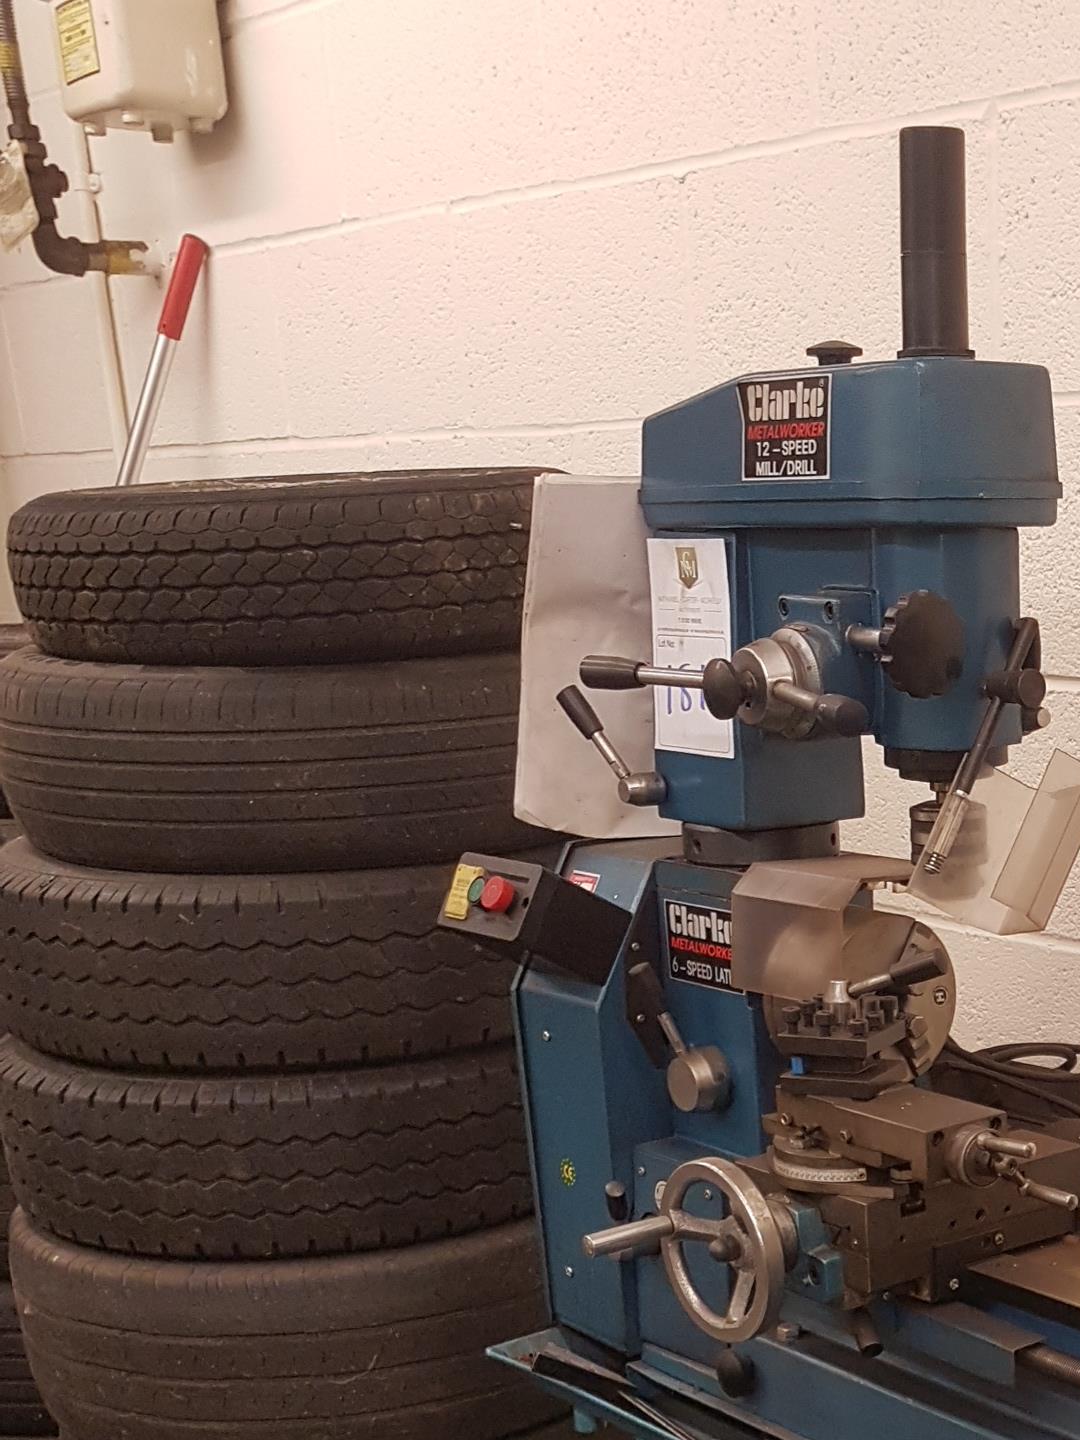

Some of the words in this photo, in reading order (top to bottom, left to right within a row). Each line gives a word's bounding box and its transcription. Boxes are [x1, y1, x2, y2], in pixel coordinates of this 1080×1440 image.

[747, 381, 825, 422] Clarke
[746, 421, 825, 440] METALWORKER
[755, 459, 817, 477] MILL/DRILL
